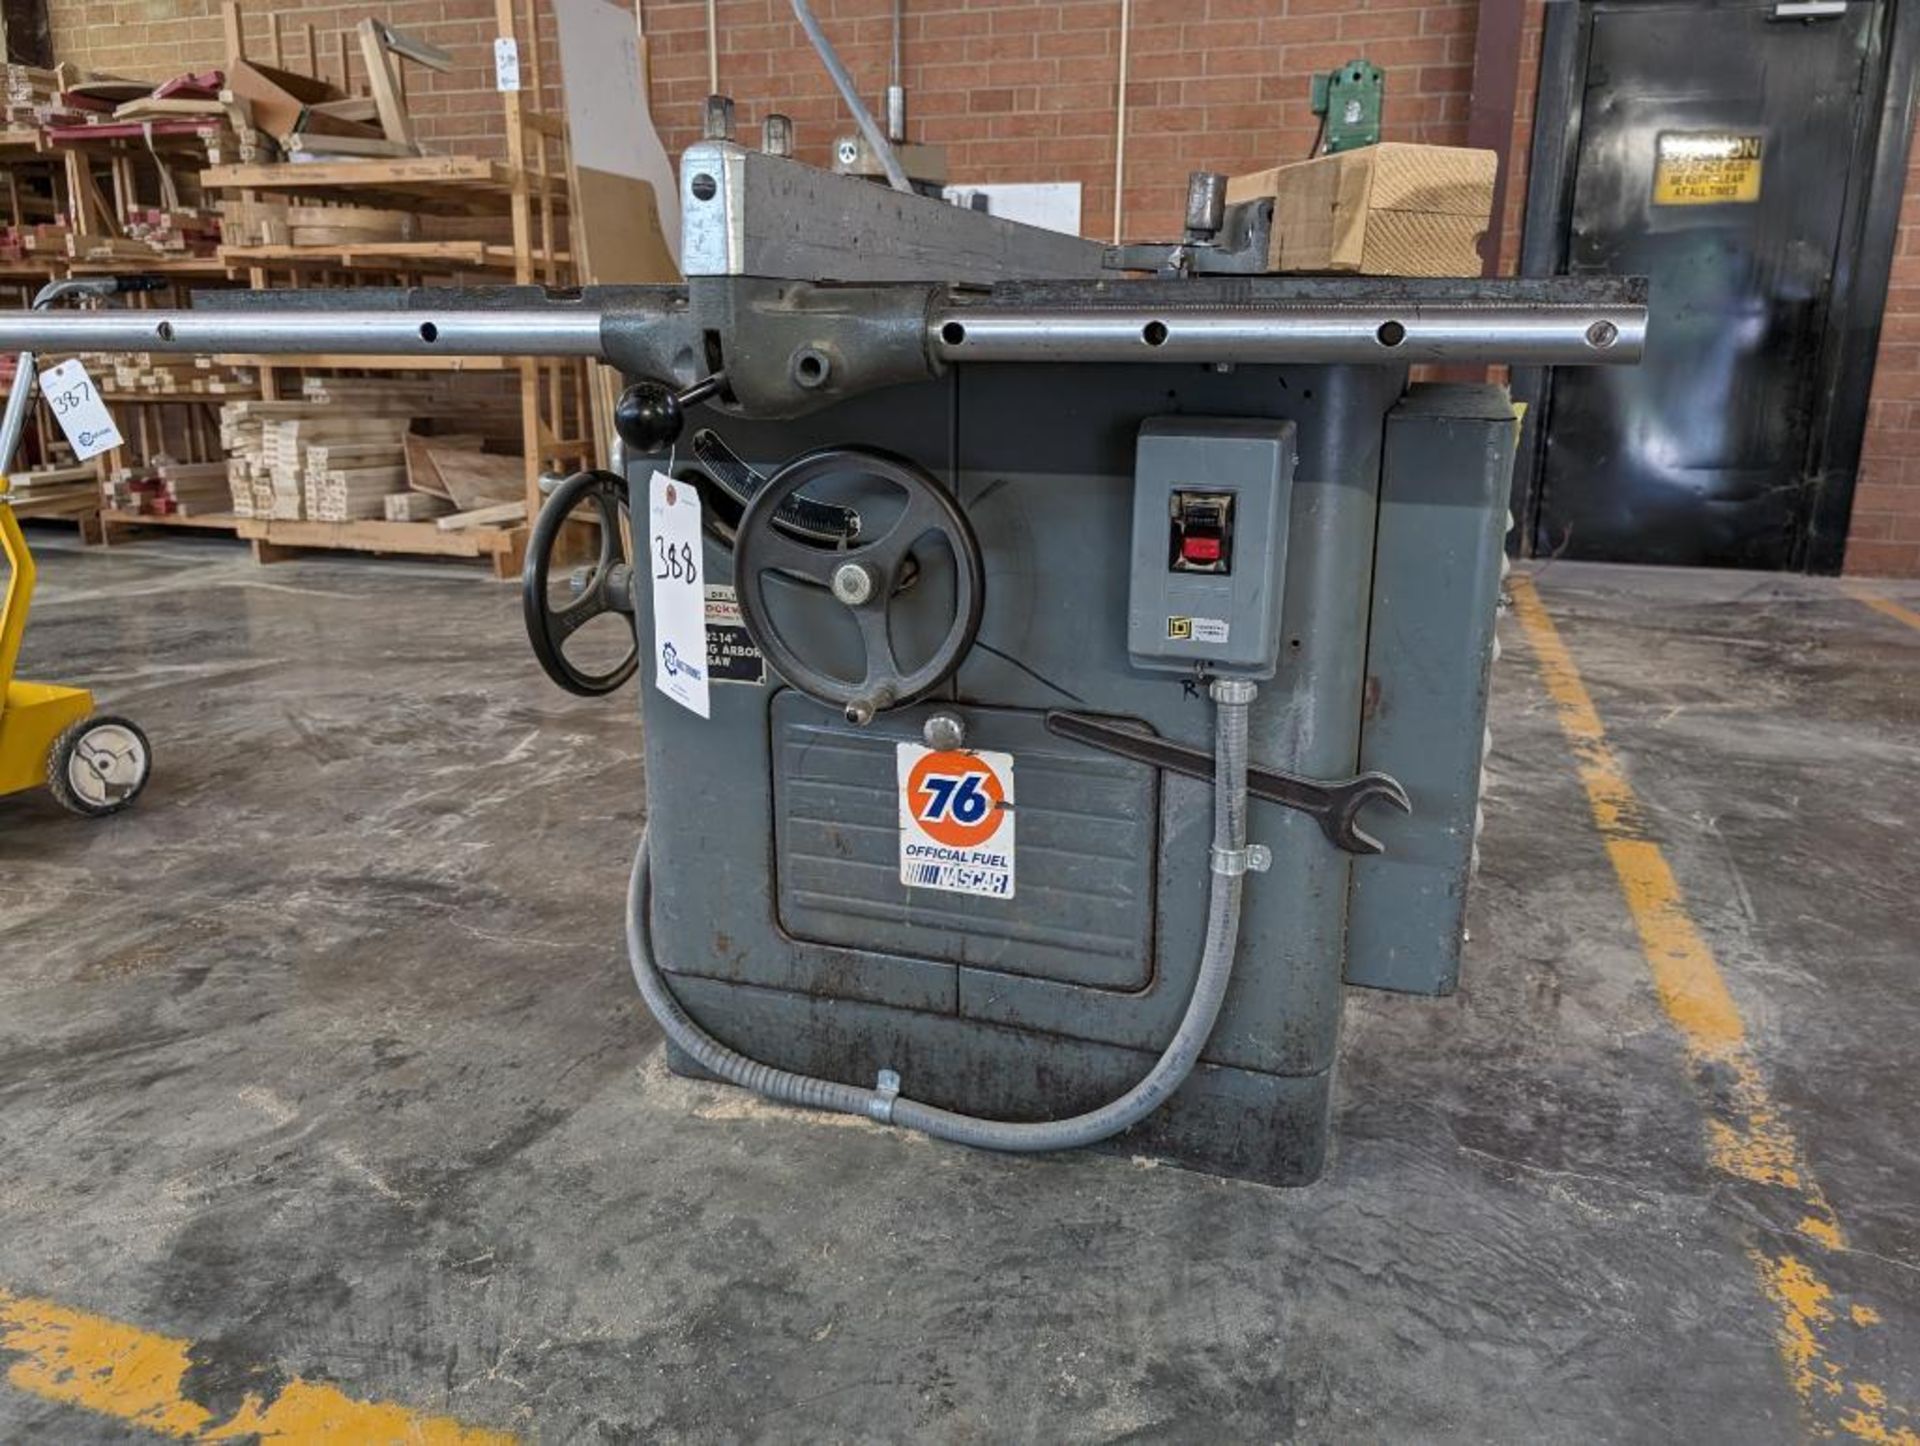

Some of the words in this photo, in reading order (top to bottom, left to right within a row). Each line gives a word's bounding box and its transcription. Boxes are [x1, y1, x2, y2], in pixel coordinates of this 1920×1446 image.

[53, 381, 90, 415] 387
[655, 535, 697, 585] 388
[722, 645, 762, 658] ARBOR
[923, 774, 987, 825] 76
[906, 845, 968, 863] OFFICIAL
[971, 852, 1008, 868] FUEL
[938, 864, 1009, 894] NASCAR
